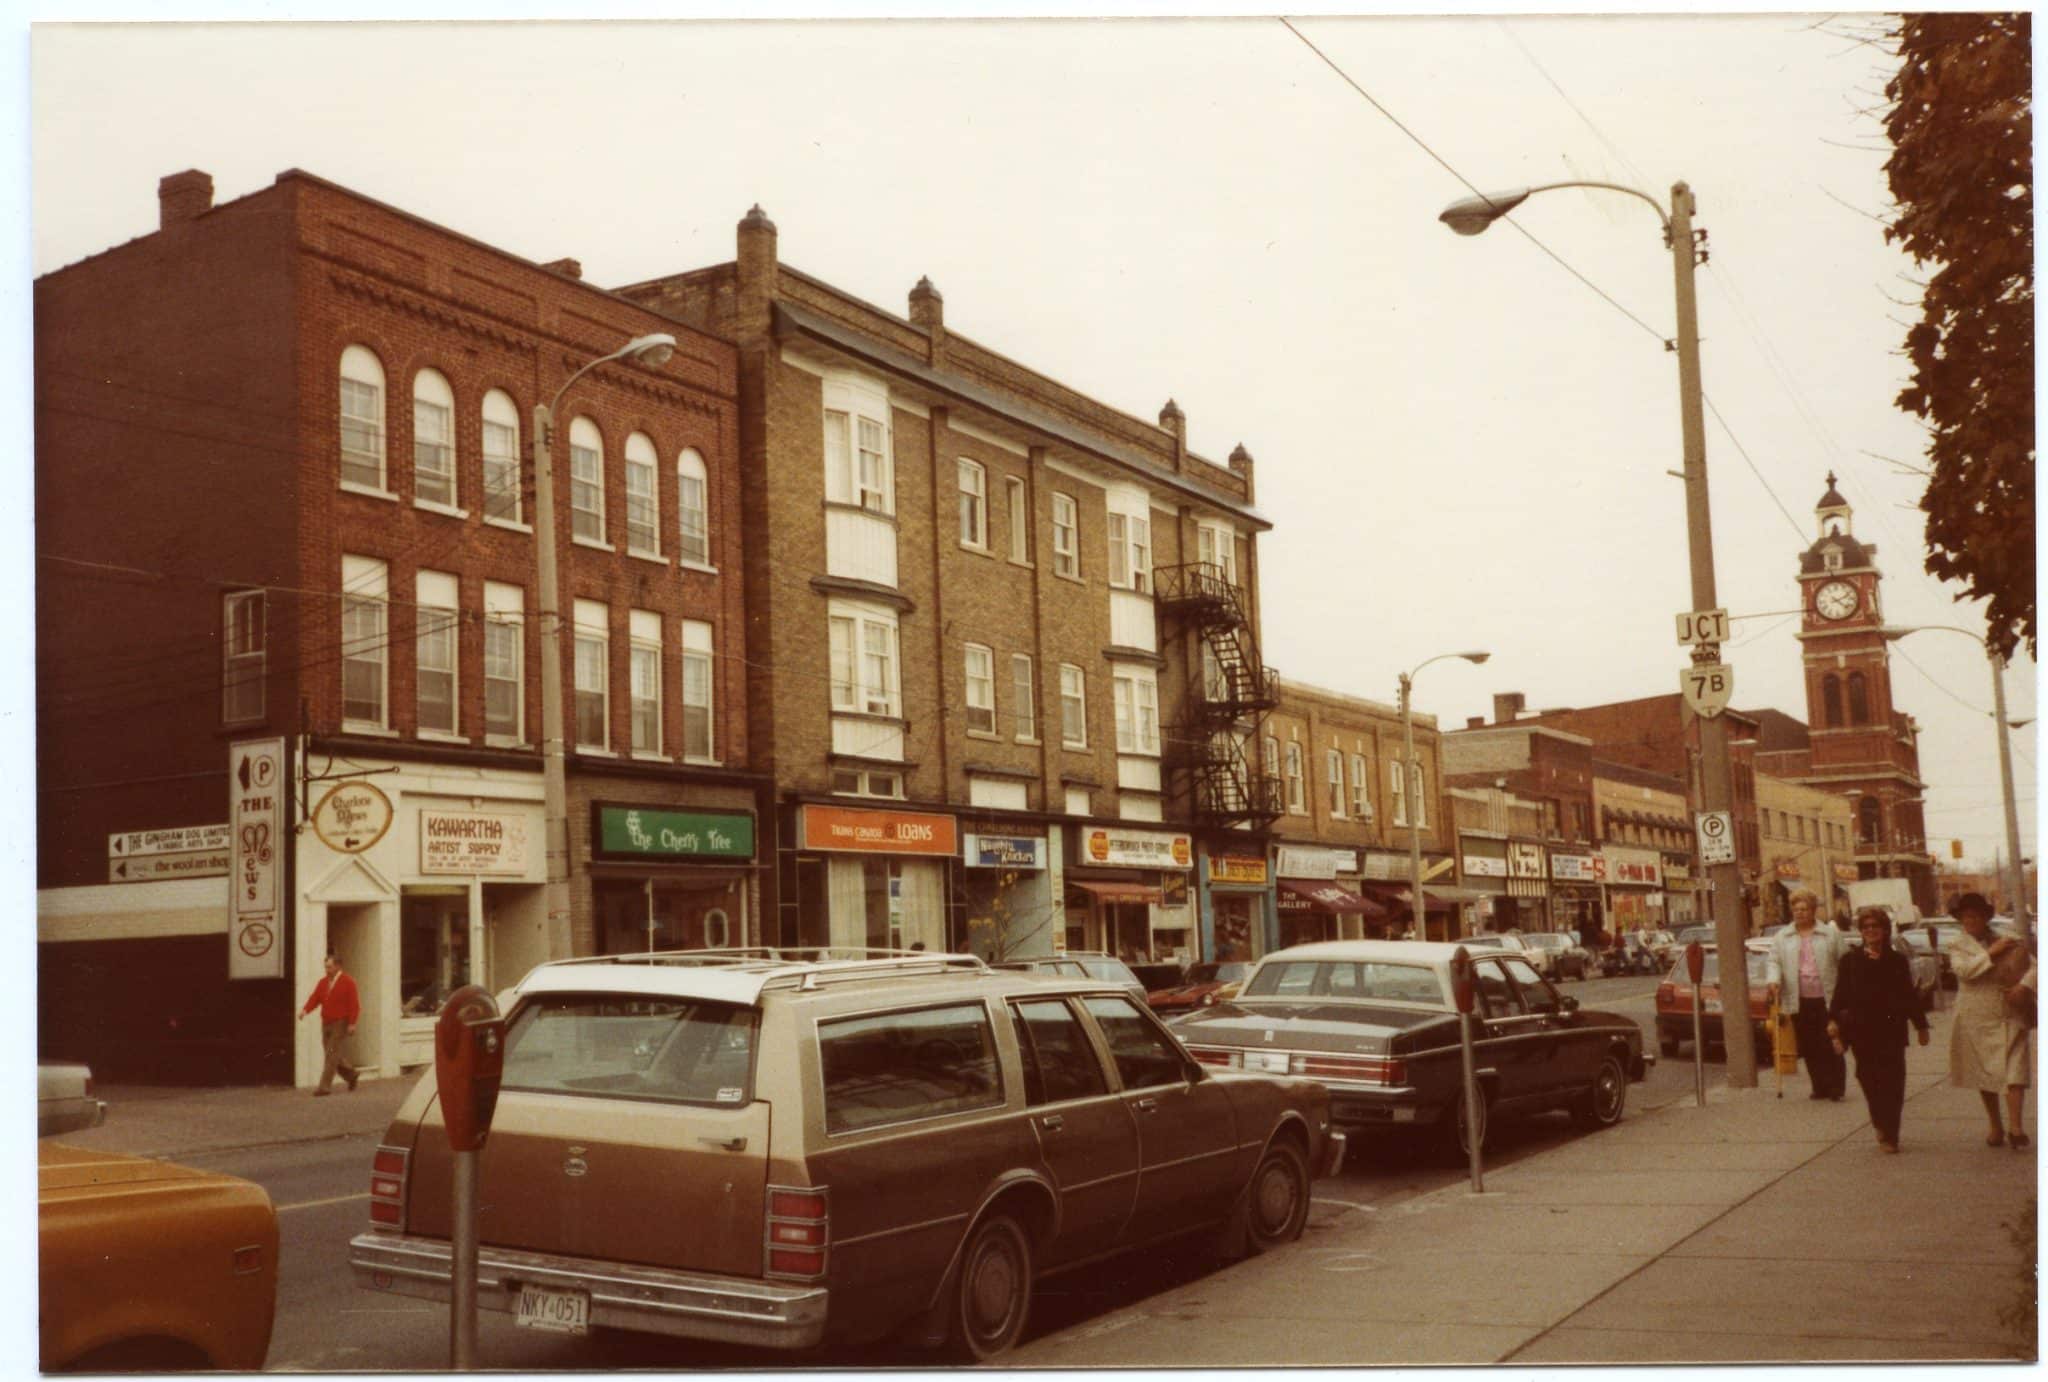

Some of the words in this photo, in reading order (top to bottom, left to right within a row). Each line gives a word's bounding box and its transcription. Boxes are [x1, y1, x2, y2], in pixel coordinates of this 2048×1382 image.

[1680, 613, 1724, 641] JCT
[1690, 674, 1724, 700] 7B
[259, 761, 271, 781] P
[241, 796, 273, 813] THE
[427, 817, 503, 840] KAWARTHA
[1709, 820, 1720, 834] P
[427, 840, 462, 855] ARTIST
[468, 842, 502, 856] SUPPLY
[661, 828, 700, 852] Cherry
[707, 827, 732, 849] Tree
[1278, 901, 1312, 910] GALLERY
[520, 1292, 549, 1319] NKY
[556, 1296, 582, 1323] 051
